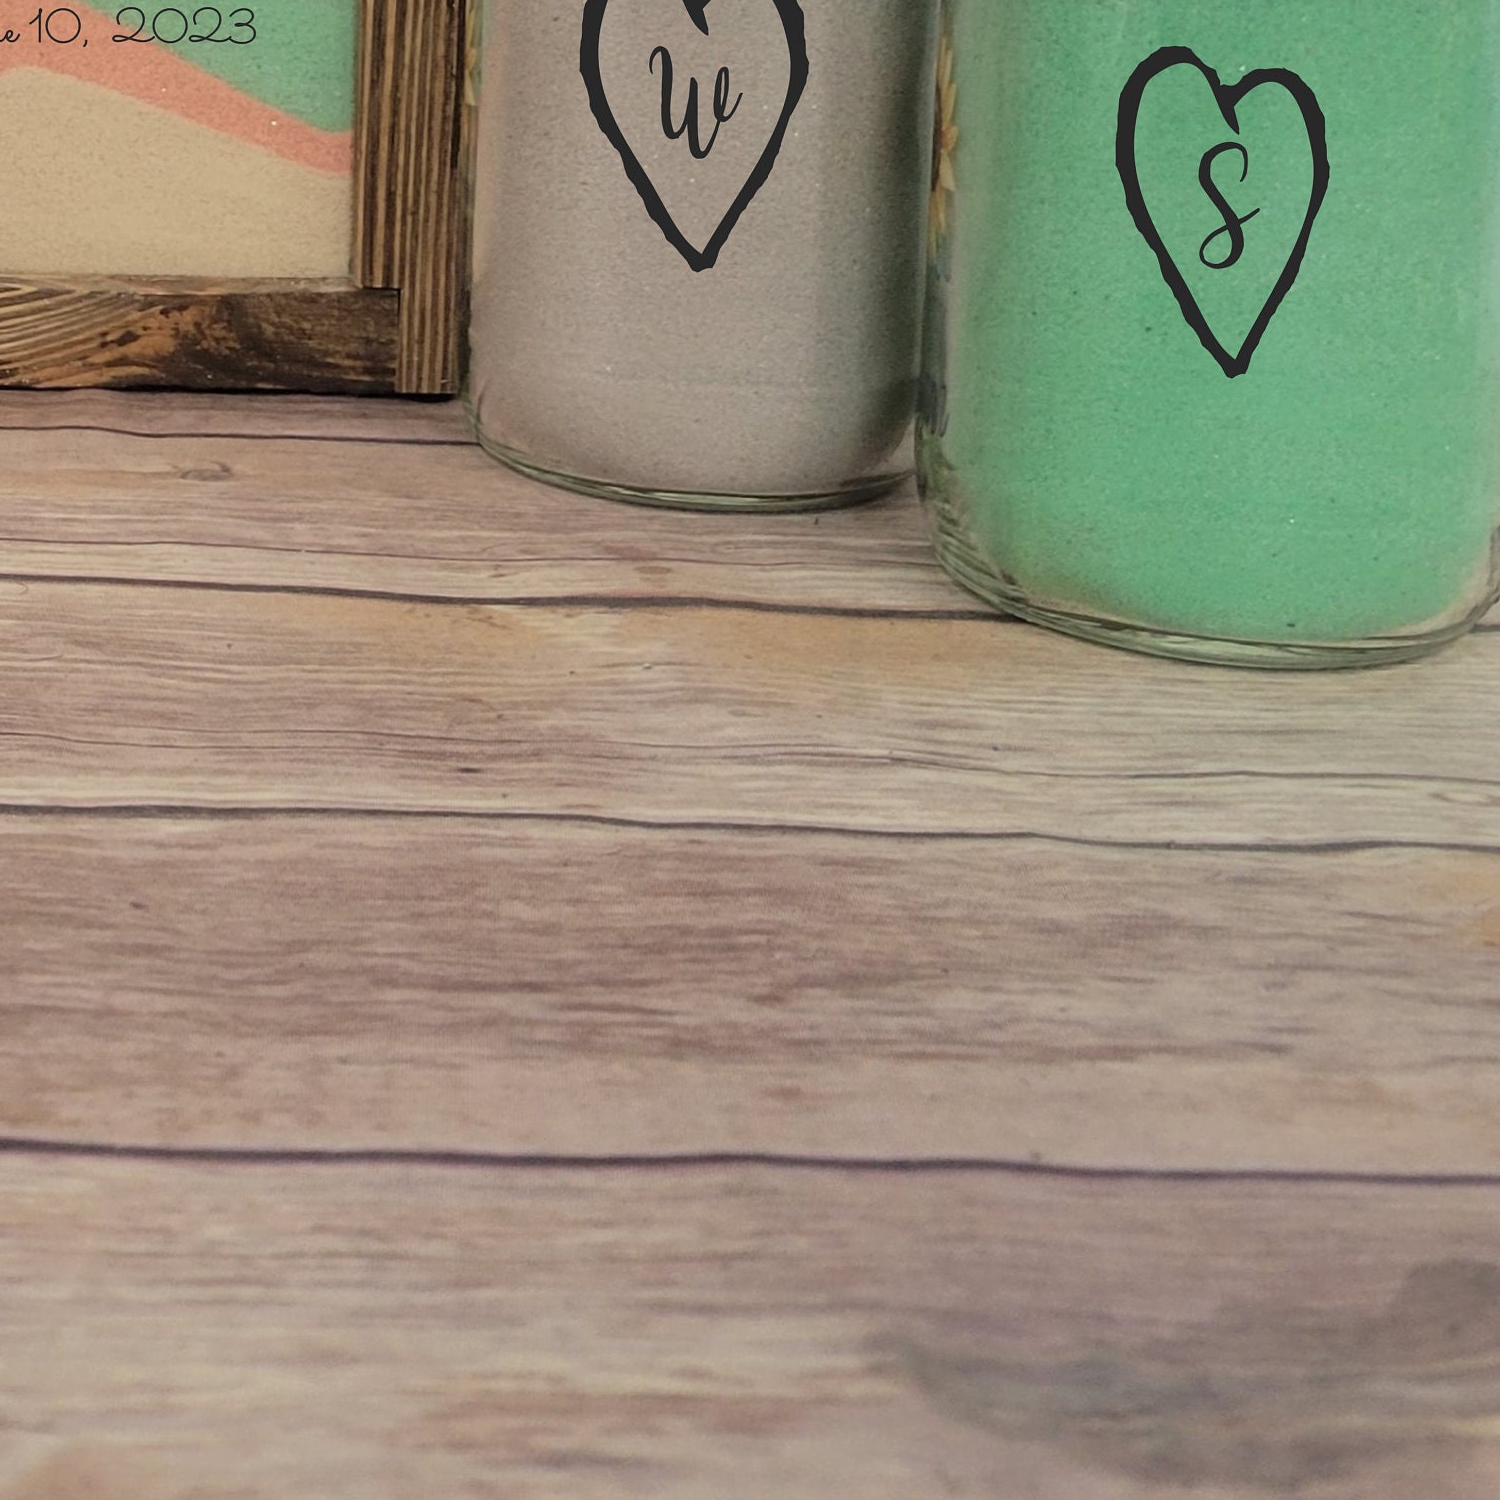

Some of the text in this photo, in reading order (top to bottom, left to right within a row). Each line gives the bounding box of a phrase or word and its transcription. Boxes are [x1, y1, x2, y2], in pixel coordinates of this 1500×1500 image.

[28, 6, 89, 47] 10,
[111, 6, 257, 45] 2023
[1199, 141, 1260, 269] S
